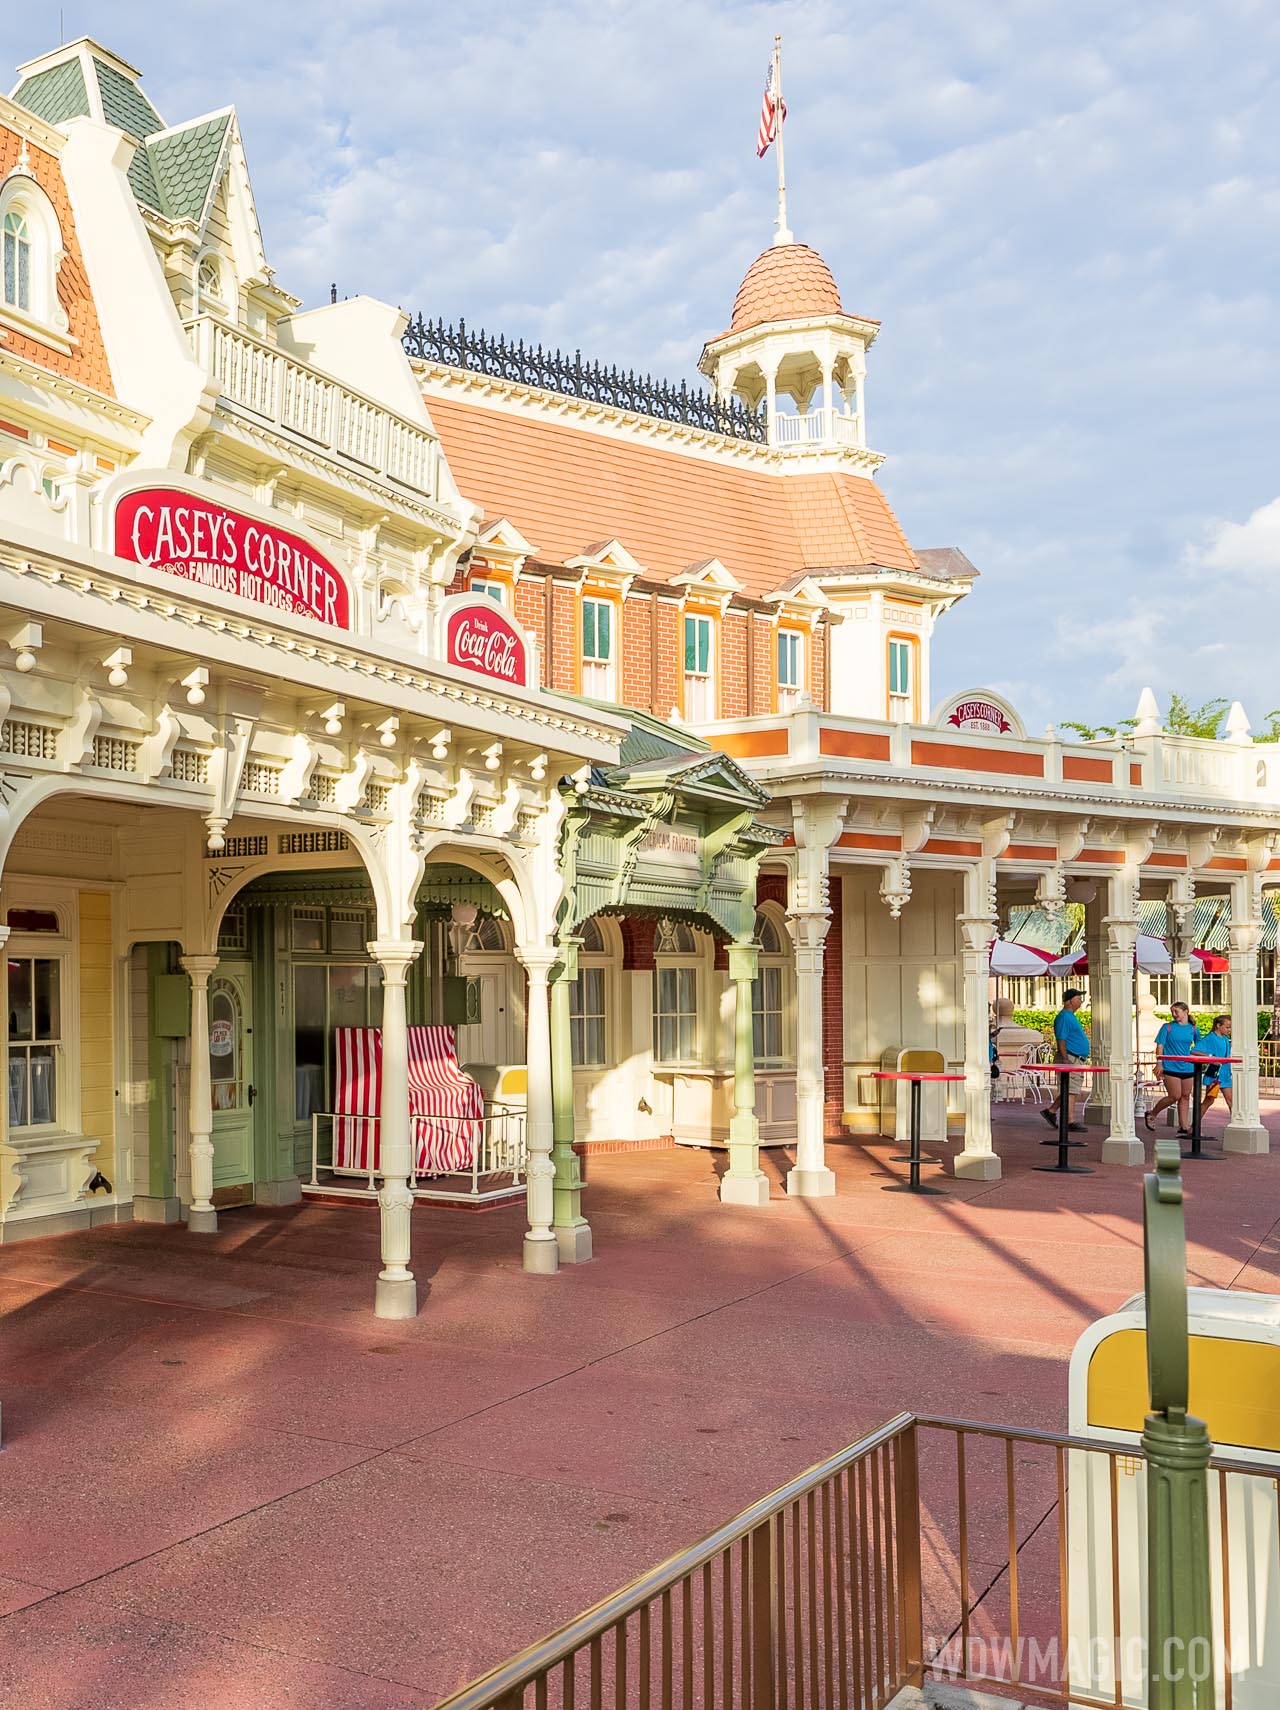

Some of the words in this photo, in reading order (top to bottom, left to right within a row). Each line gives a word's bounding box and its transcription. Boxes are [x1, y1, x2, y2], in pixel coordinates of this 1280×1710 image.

[131, 505, 237, 567] CASEY'S
[243, 527, 339, 627] CORNER
[189, 561, 237, 594] FAMOUS
[239, 571, 262, 601] HOT
[263, 583, 294, 612] DOGS
[474, 618, 489, 632] Drink
[455, 620, 517, 677] Coca-Cola
[981, 704, 1002, 727] CORNER
[672, 835, 697, 854] FAVORITE
